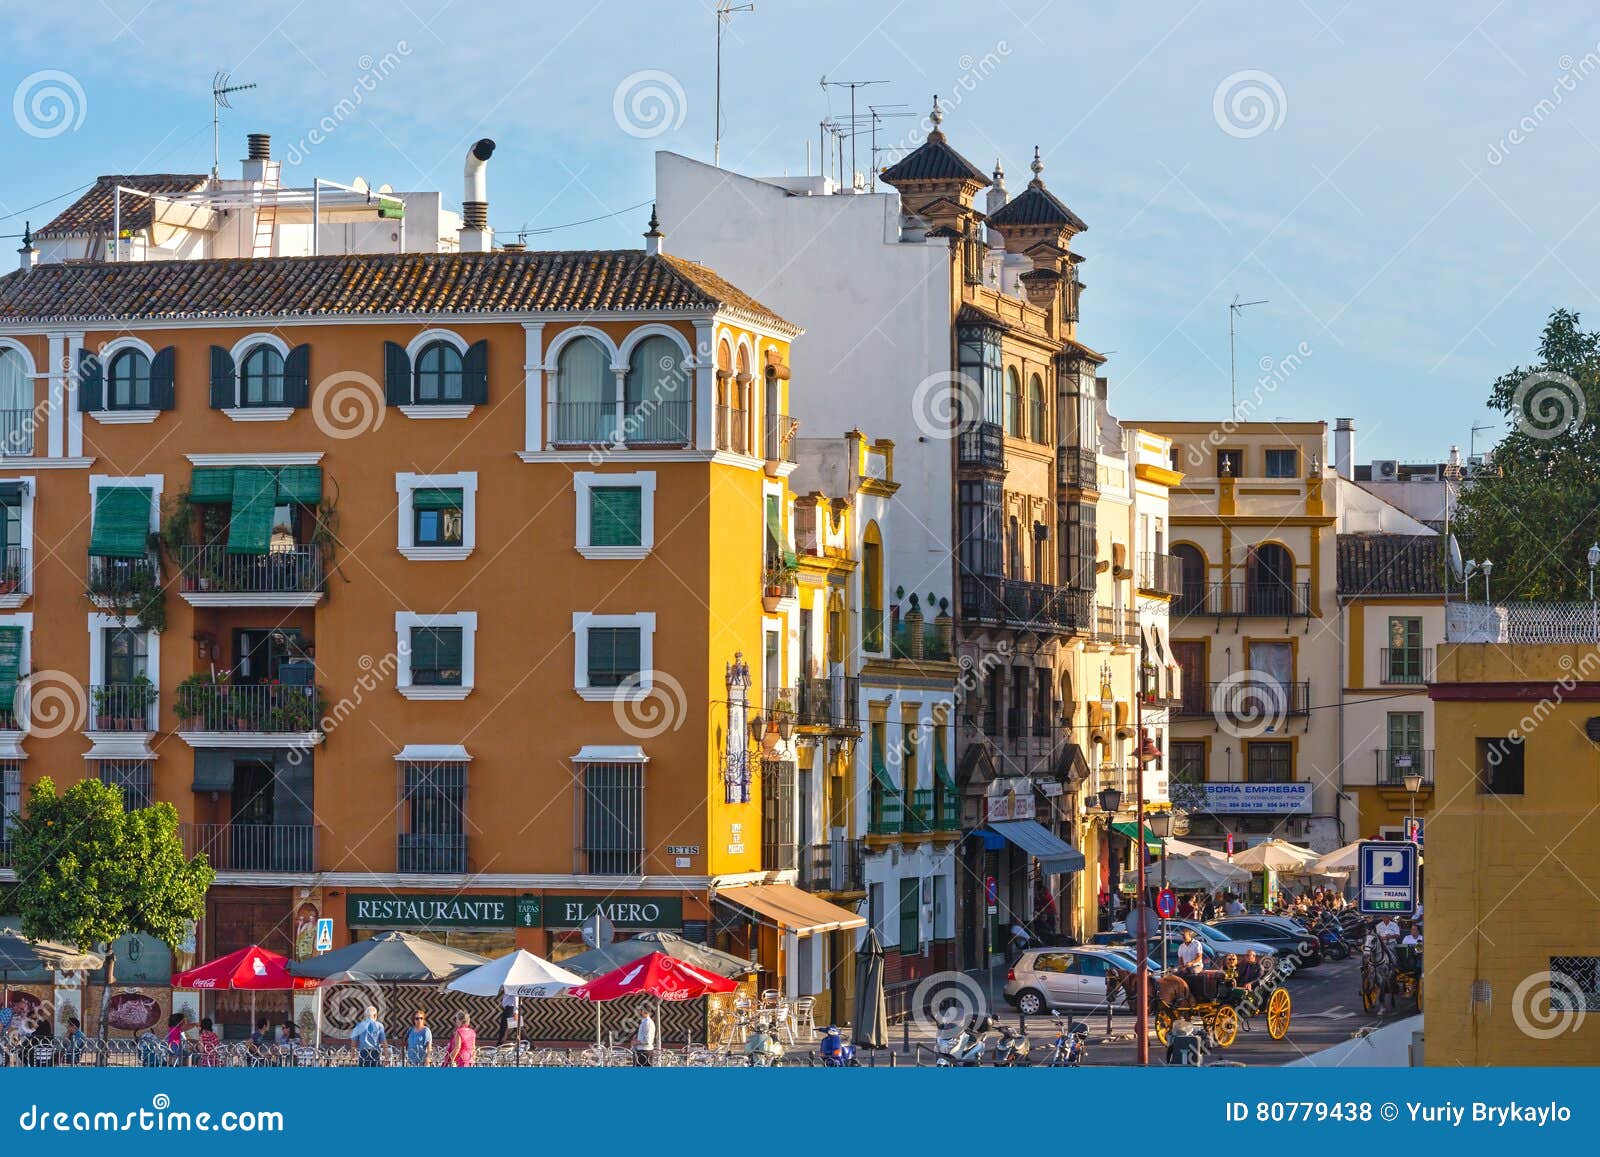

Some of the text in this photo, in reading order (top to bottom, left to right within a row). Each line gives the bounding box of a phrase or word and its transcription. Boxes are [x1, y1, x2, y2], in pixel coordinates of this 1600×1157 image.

[1245, 785, 1305, 793] EMPRESAS
[667, 846, 698, 854] BETIS
[1373, 851, 1403, 885] P
[518, 904, 540, 913] TAPAS
[1375, 901, 1400, 909] LIBRE
[358, 900, 505, 920] RESTAURANTE
[565, 903, 660, 922] EL MERO
